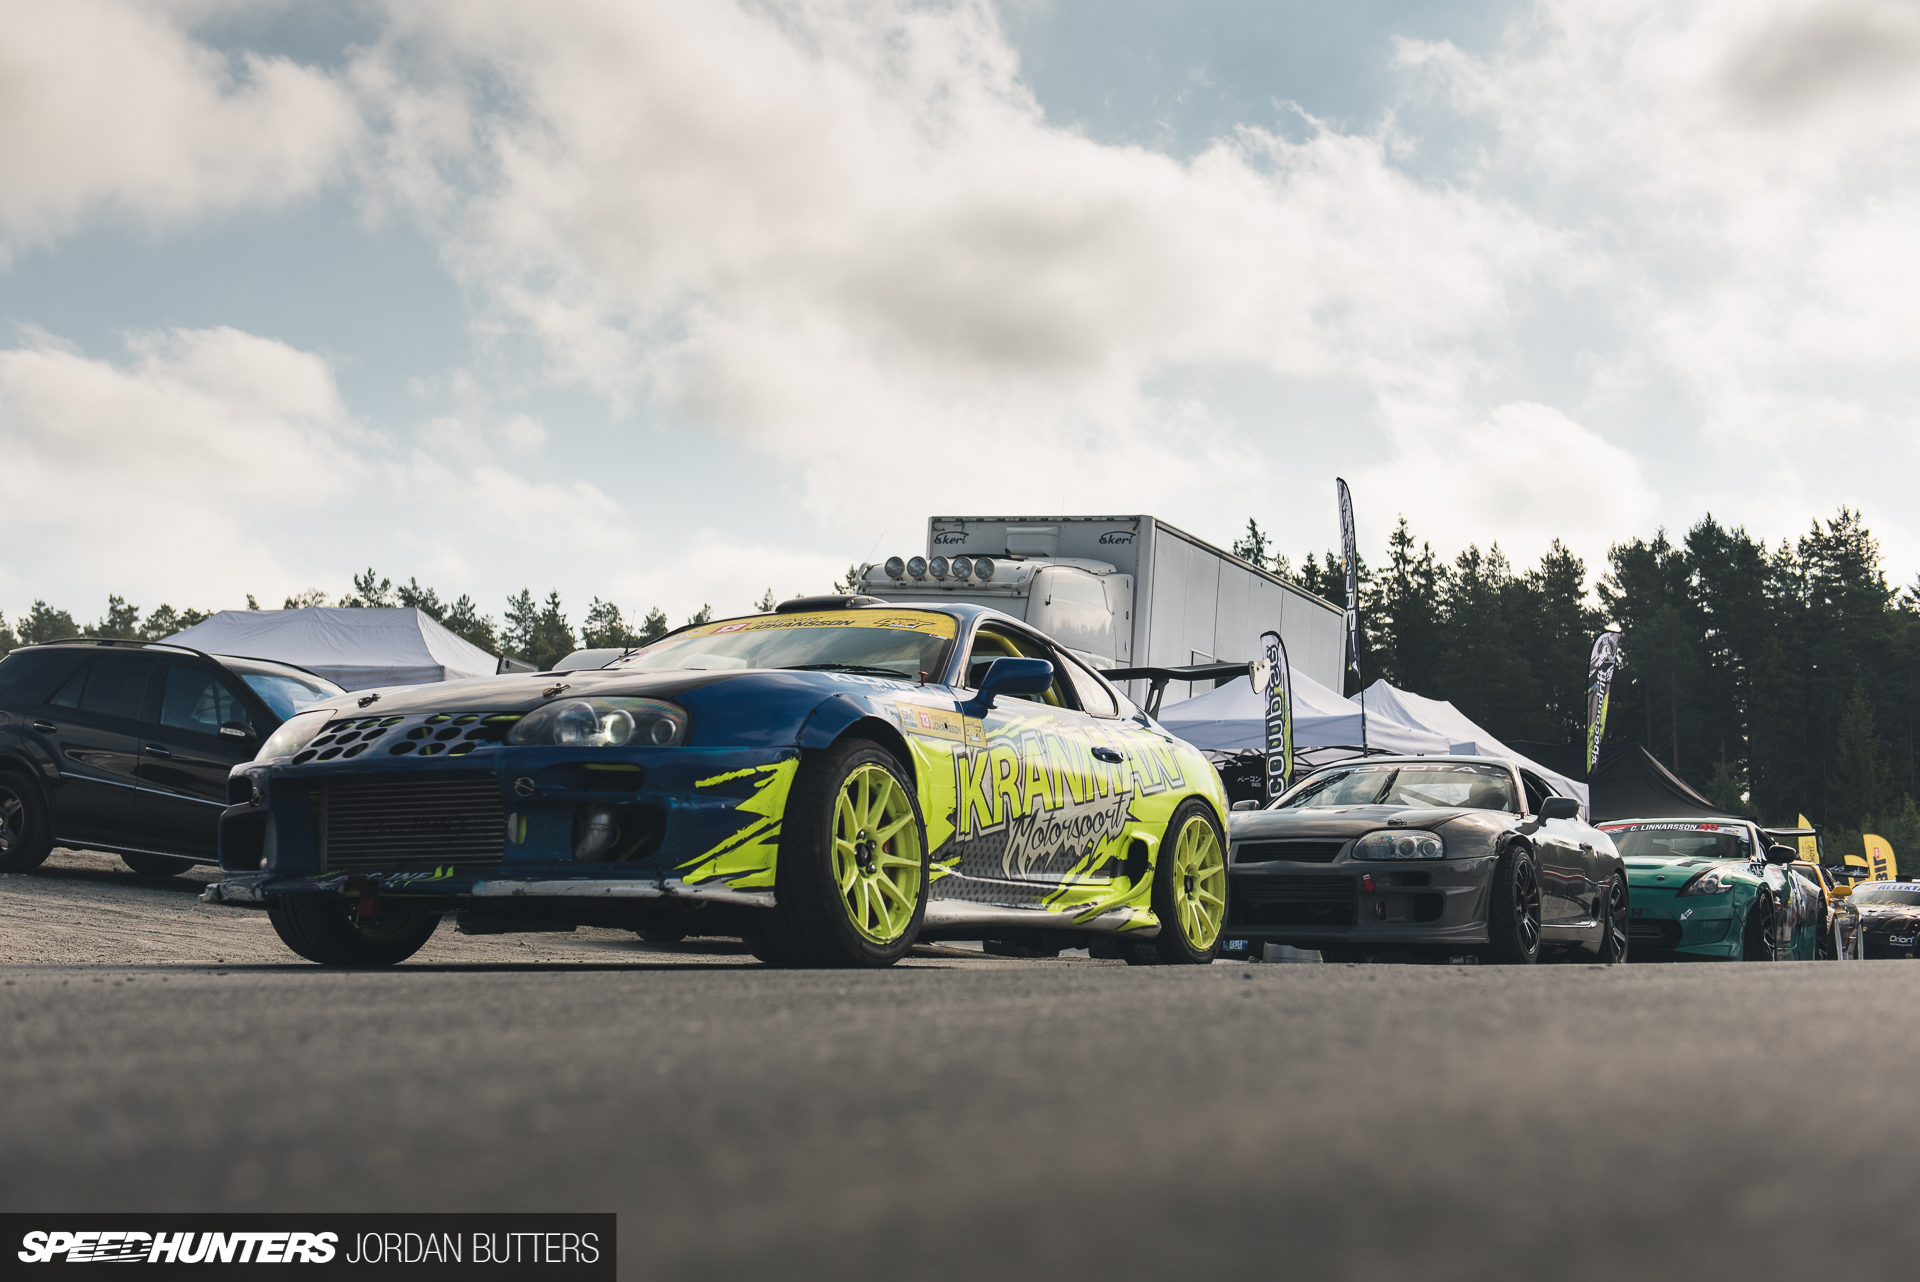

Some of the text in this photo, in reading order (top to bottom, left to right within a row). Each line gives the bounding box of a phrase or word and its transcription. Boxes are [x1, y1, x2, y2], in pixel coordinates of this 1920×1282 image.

[745, 620, 856, 630] JOHANSSON
[920, 713, 931, 727] 13
[1591, 669, 1607, 764] #bacondrift
[954, 727, 1186, 841] KRANMAN
[1699, 823, 1718, 831] 40
[1890, 935, 1913, 943] Orion
